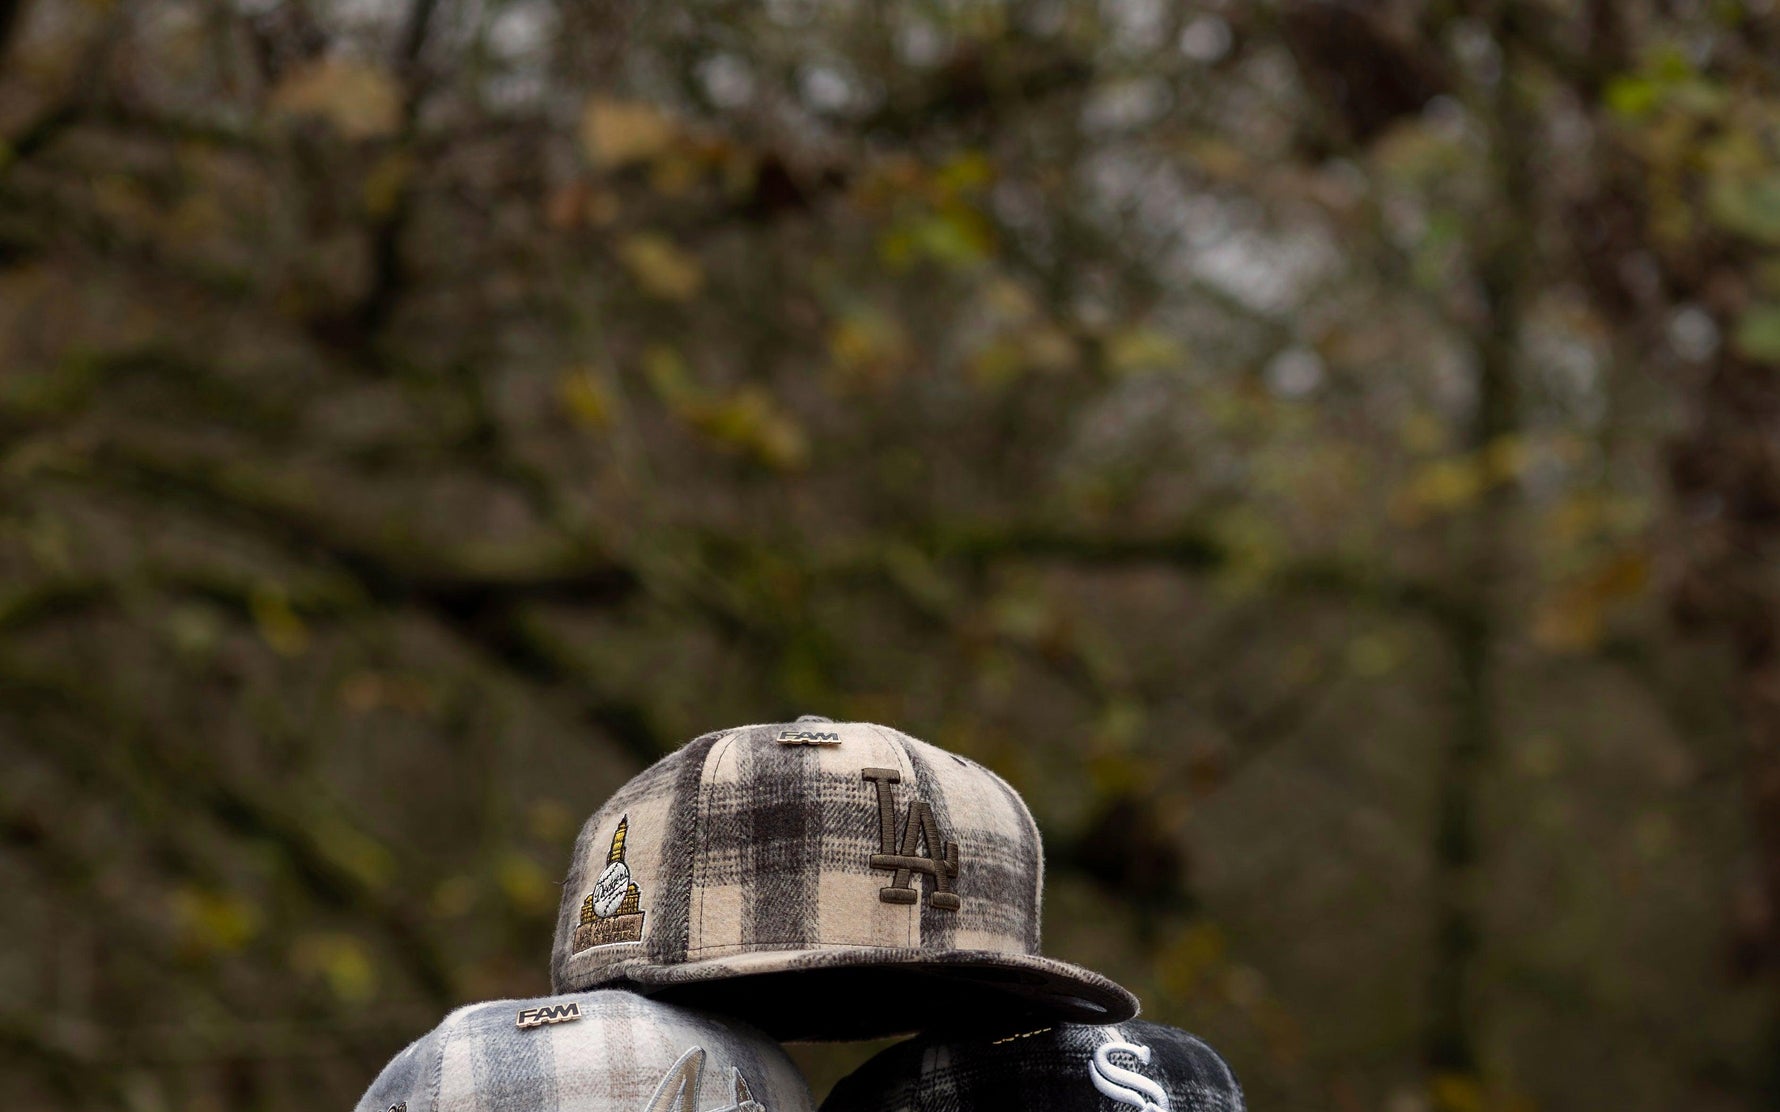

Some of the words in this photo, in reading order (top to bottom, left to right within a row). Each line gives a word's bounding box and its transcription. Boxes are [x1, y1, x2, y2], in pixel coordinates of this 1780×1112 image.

[777, 731, 841, 742] FAM
[861, 767, 961, 911] LA
[517, 1002, 581, 1025] FAM
